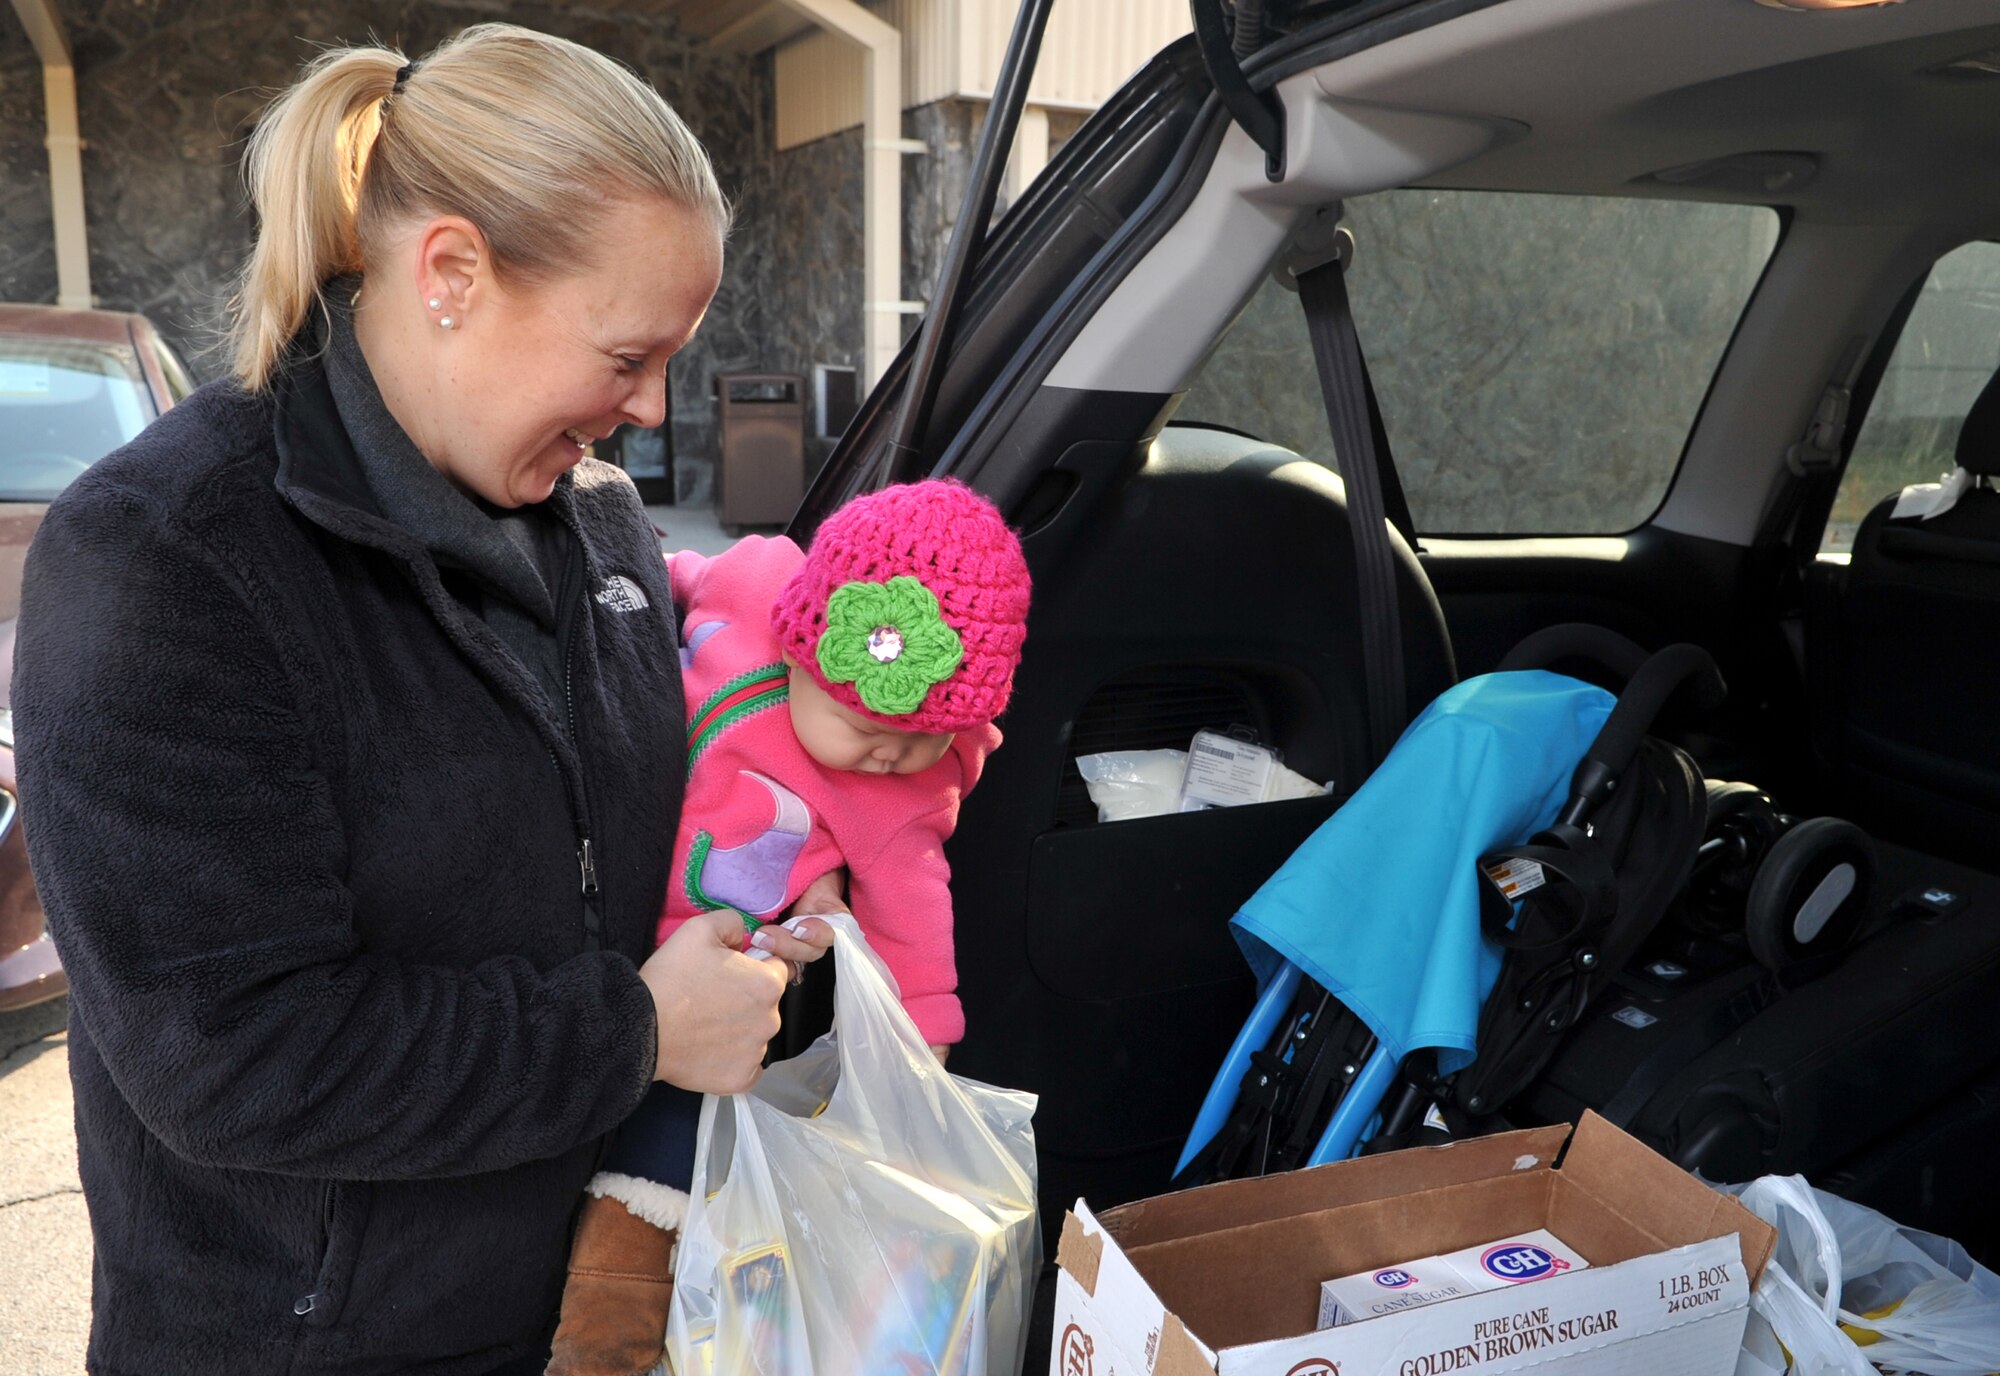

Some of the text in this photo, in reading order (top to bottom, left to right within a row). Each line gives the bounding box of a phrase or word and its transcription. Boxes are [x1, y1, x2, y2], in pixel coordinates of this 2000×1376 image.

[594, 587, 628, 604] NORTH
[602, 576, 622, 589] HE
[609, 599, 633, 613] FACE
[1492, 1249, 1549, 1275] C&H
[1658, 1264, 1730, 1299] 1 LB. BOX
[1371, 1298, 1413, 1314] CANE
[1412, 1286, 1461, 1305] SUGAR
[1668, 1289, 1721, 1313] 24 COUNT
[1474, 1307, 1549, 1341] PURE CANE
[1400, 1309, 1619, 1376] GOLDEN BROWN SUGAR
